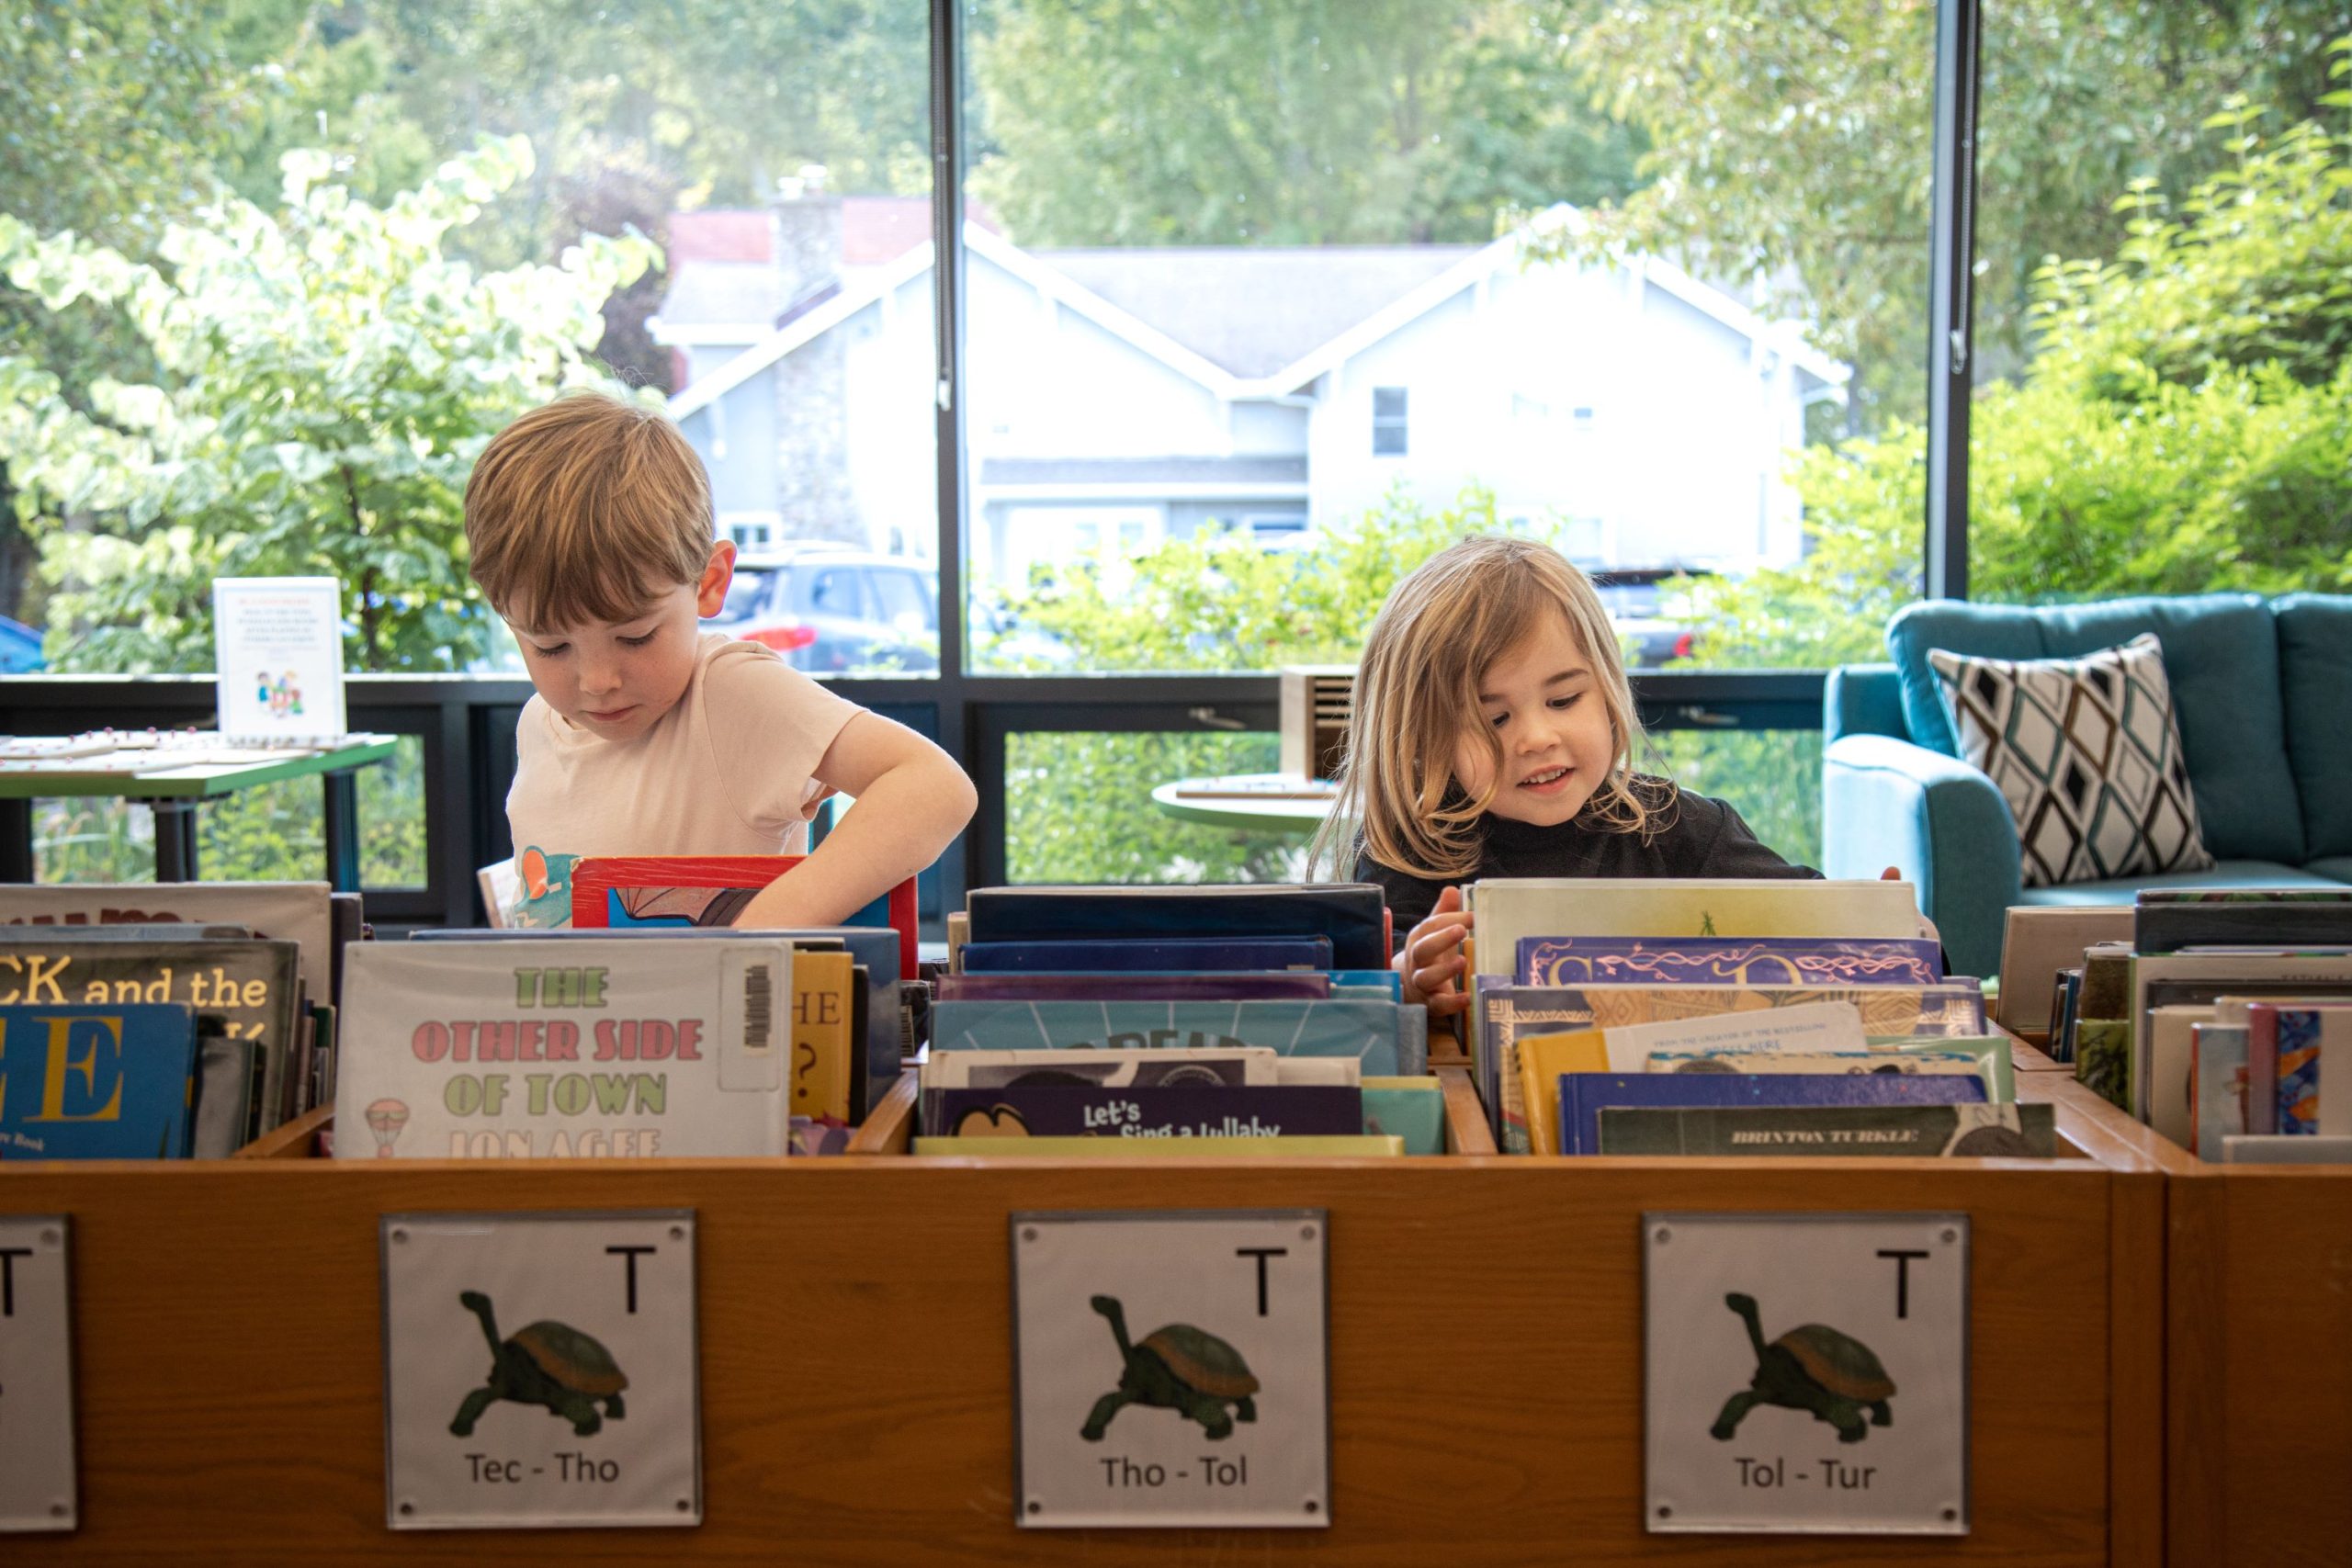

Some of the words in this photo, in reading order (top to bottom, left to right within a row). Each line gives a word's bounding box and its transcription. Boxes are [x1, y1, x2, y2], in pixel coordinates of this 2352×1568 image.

[84, 967, 173, 1003] and
[190, 967, 267, 1008] the
[514, 966, 609, 1009] THE
[412, 1020, 580, 1063] OTHER
[593, 1019, 704, 1061] SIDE
[444, 1074, 510, 1116] OF
[526, 1073, 667, 1116] TOWN
[1083, 1100, 1141, 1127] Let's
[0, 1248, 33, 1316] T
[605, 1246, 657, 1314] T
[1236, 1247, 1288, 1316] T
[1876, 1249, 1930, 1319] T
[465, 1453, 522, 1483] Tec
[554, 1451, 619, 1483] Tho
[1100, 1455, 1166, 1487] Tho
[1199, 1454, 1248, 1486] Tol
[1735, 1457, 1784, 1488] Tol
[1818, 1459, 1877, 1490] Tur
